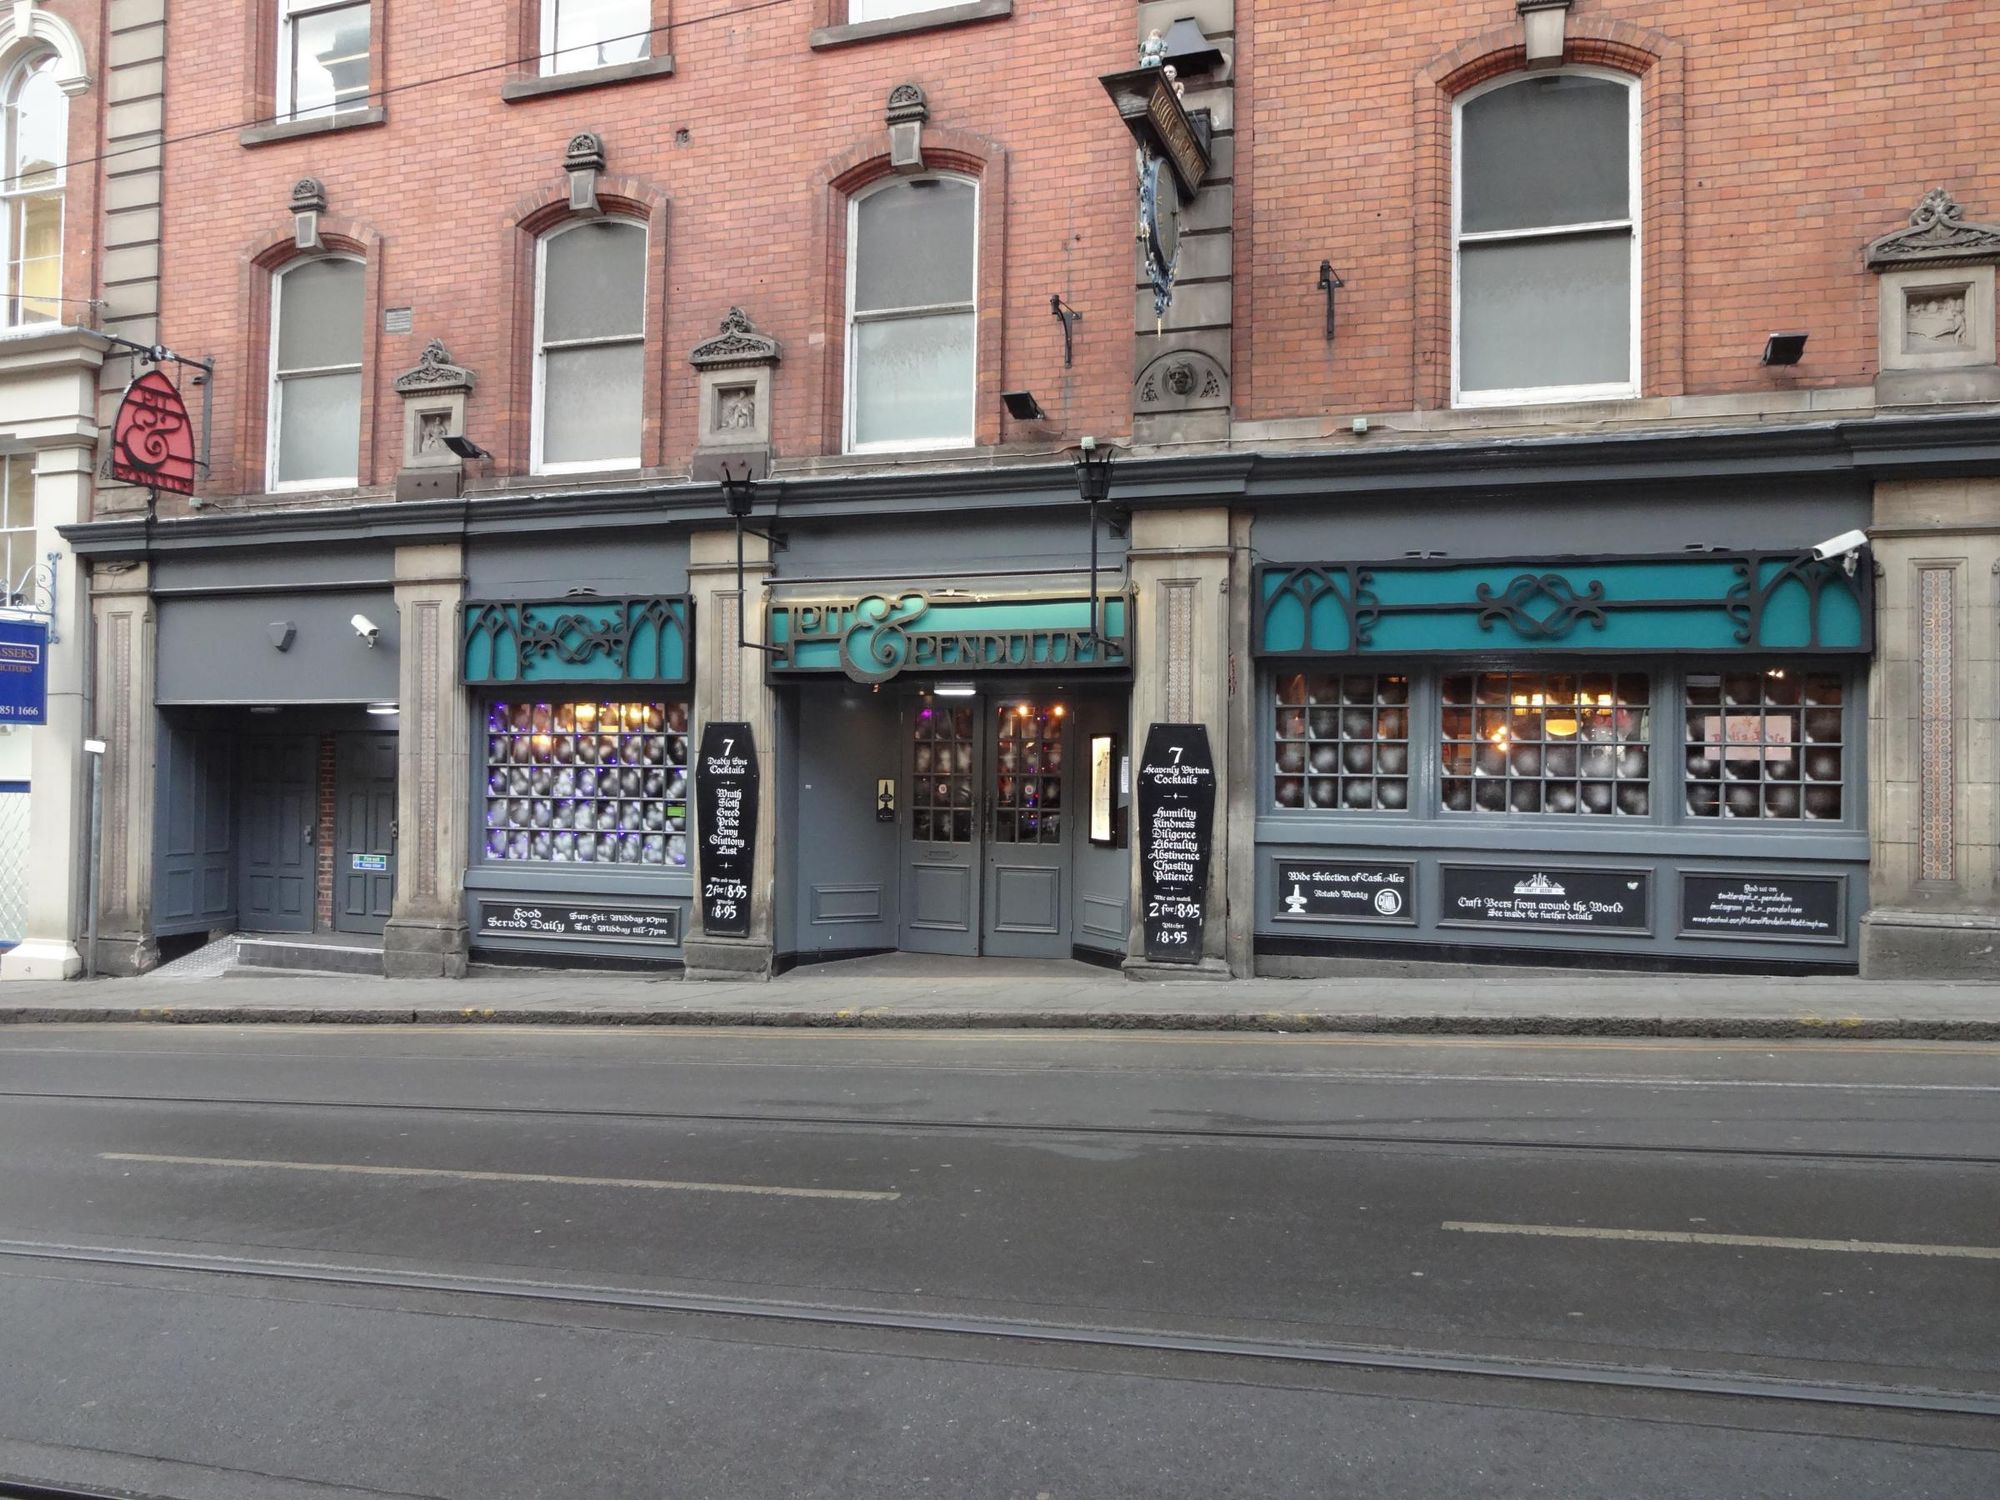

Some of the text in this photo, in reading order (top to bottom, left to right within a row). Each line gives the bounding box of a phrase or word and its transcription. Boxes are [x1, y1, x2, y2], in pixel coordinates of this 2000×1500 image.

[140, 389, 168, 412] PIT
[123, 406, 184, 473] &
[793, 604, 854, 634] PIT
[839, 588, 930, 684] &
[907, 630, 1098, 668] PENDULUM
[18, 706, 39, 716] 1666
[723, 738, 735, 757] 7
[707, 756, 748, 767] Deadly Sins
[1168, 746, 1184, 765] 7
[709, 764, 745, 775] Cocktails
[1142, 763, 1210, 777] Heavenly Virtues
[1153, 773, 1198, 785] Cocktails
[715, 788, 742, 801] Wrath
[718, 798, 740, 810] Sloth
[716, 807, 740, 817] Greed
[1152, 806, 1197, 821] Humility
[715, 816, 740, 829] Pride
[1152, 817, 1196, 829] Kindness
[717, 826, 739, 838] Envy
[1151, 828, 1197, 842] Diligence
[709, 833, 745, 848] Gluttony
[1151, 838, 1198, 853] Liberality
[716, 845, 737, 855] Lust
[1147, 848, 1201, 861] Abstinence
[1152, 859, 1194, 874] Chastity
[1152, 870, 1195, 884] Patience
[1287, 871, 1406, 884] Wide Selection of Cask Ales
[705, 883, 714, 897] 2
[712, 884, 724, 896] for
[1313, 889, 1369, 901] Rotated Weekly
[1148, 902, 1160, 917] 2
[1160, 903, 1175, 916] for
[1457, 896, 1624, 914] Craft Beers from around the World
[512, 907, 543, 921] Food
[568, 911, 608, 924] Sun-Fri:
[1487, 907, 1593, 921] See inside for further details
[486, 916, 566, 933] Served Daily
[573, 922, 594, 933] Sat:
[595, 924, 631, 935] Midday
